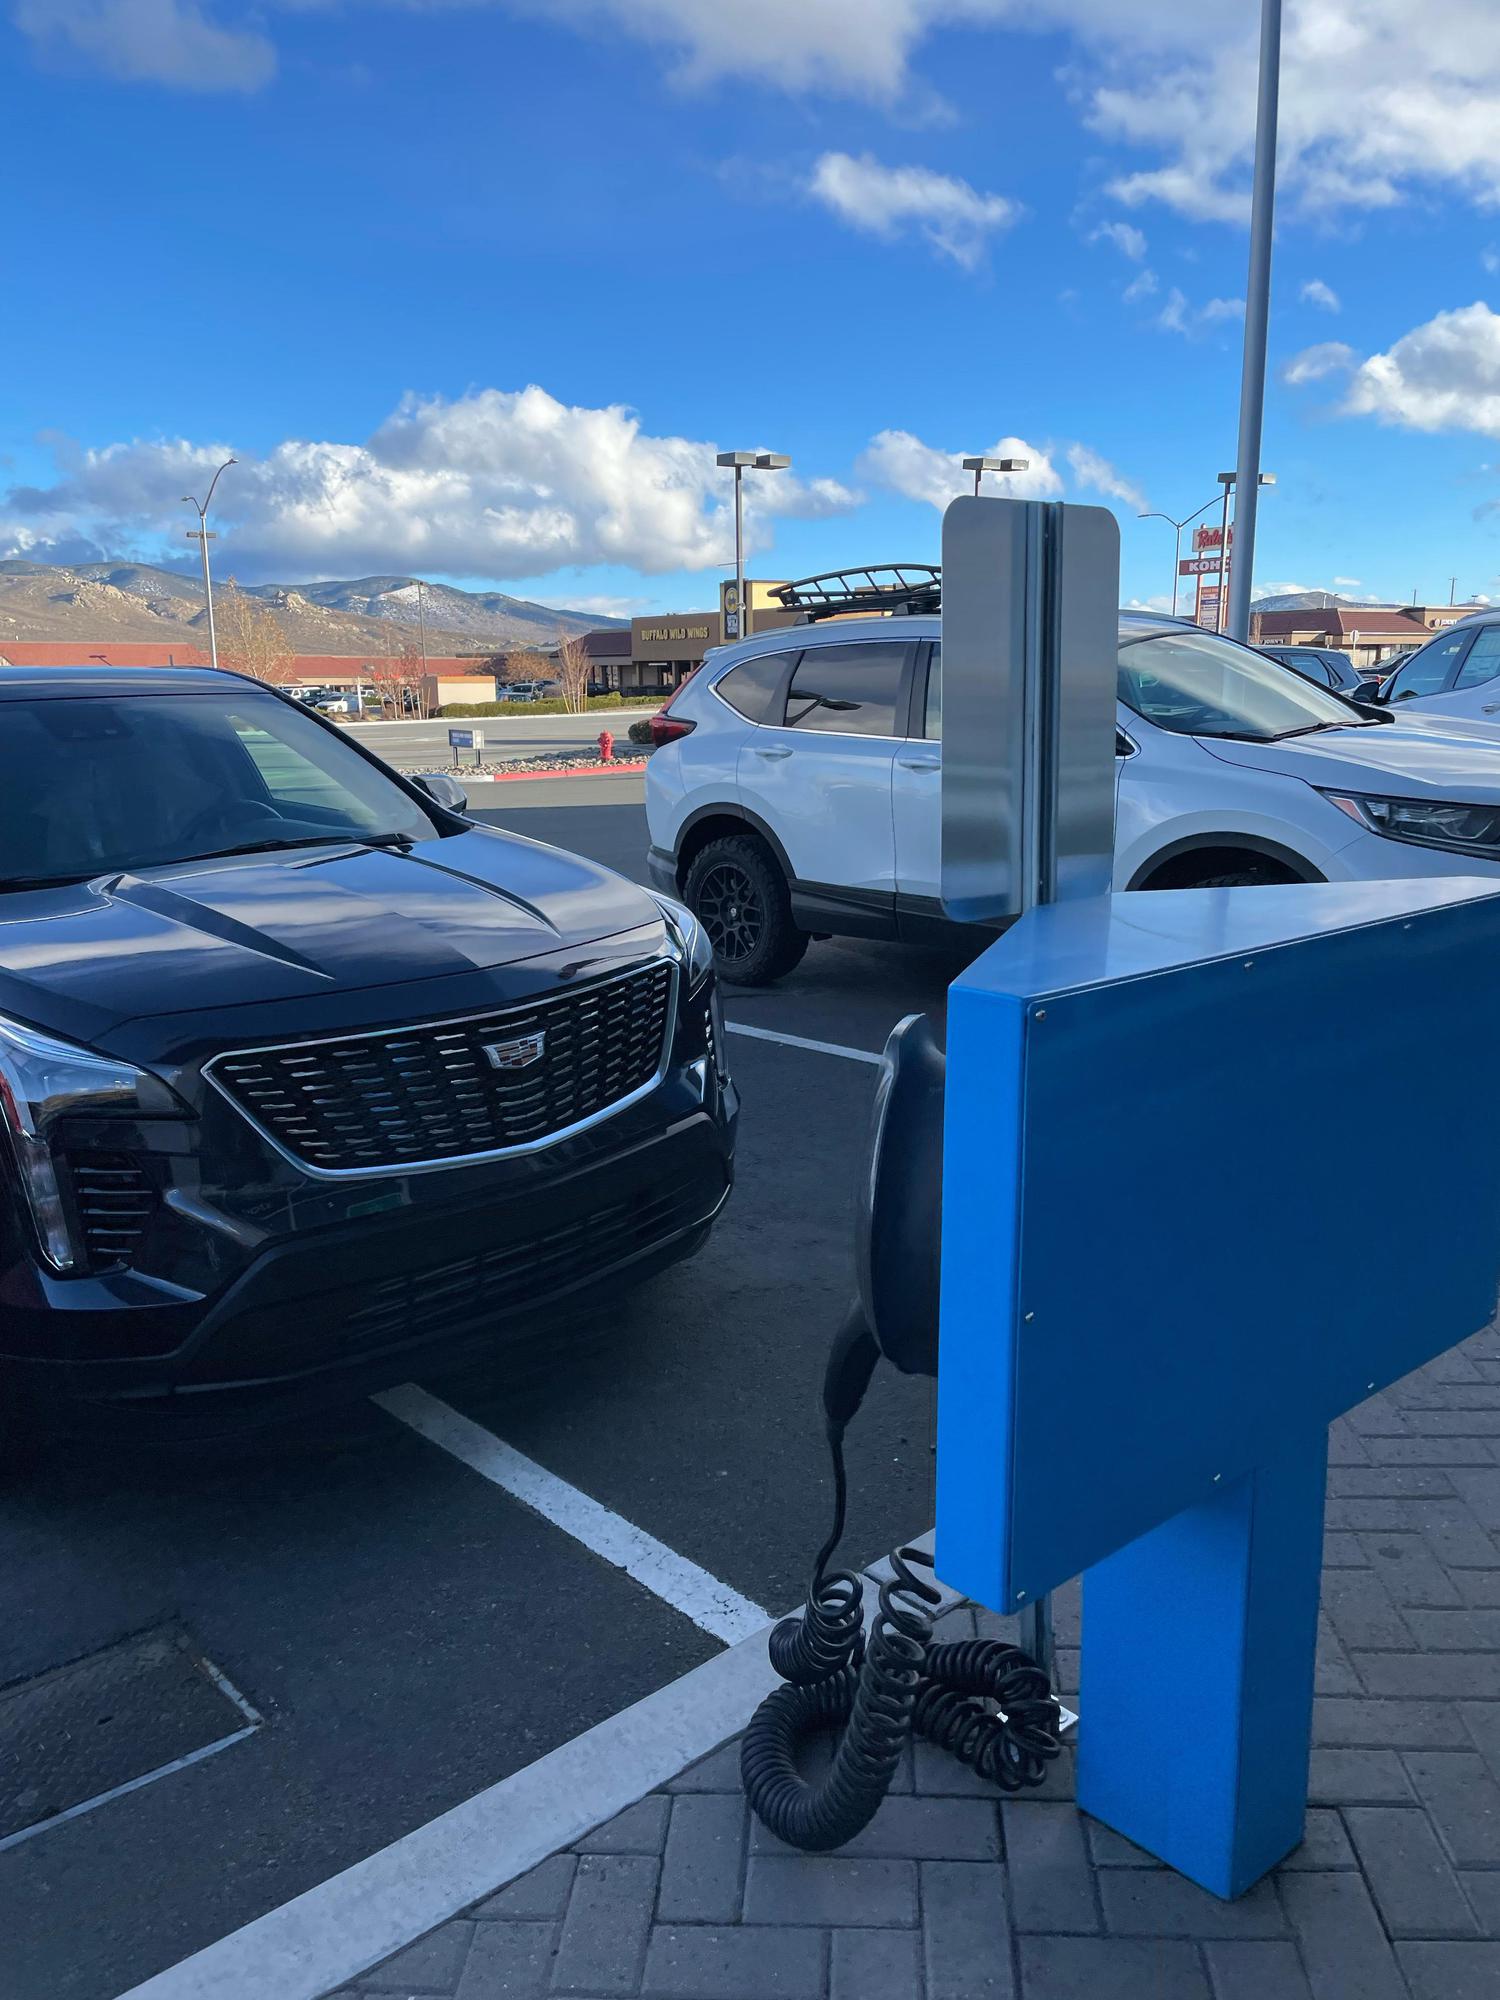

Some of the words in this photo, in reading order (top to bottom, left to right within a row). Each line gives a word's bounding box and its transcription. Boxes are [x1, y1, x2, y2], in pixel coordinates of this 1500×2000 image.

[641, 629, 669, 640] BUFFALO
[669, 628, 686, 640] WILD
[687, 626, 709, 639] WINGS
